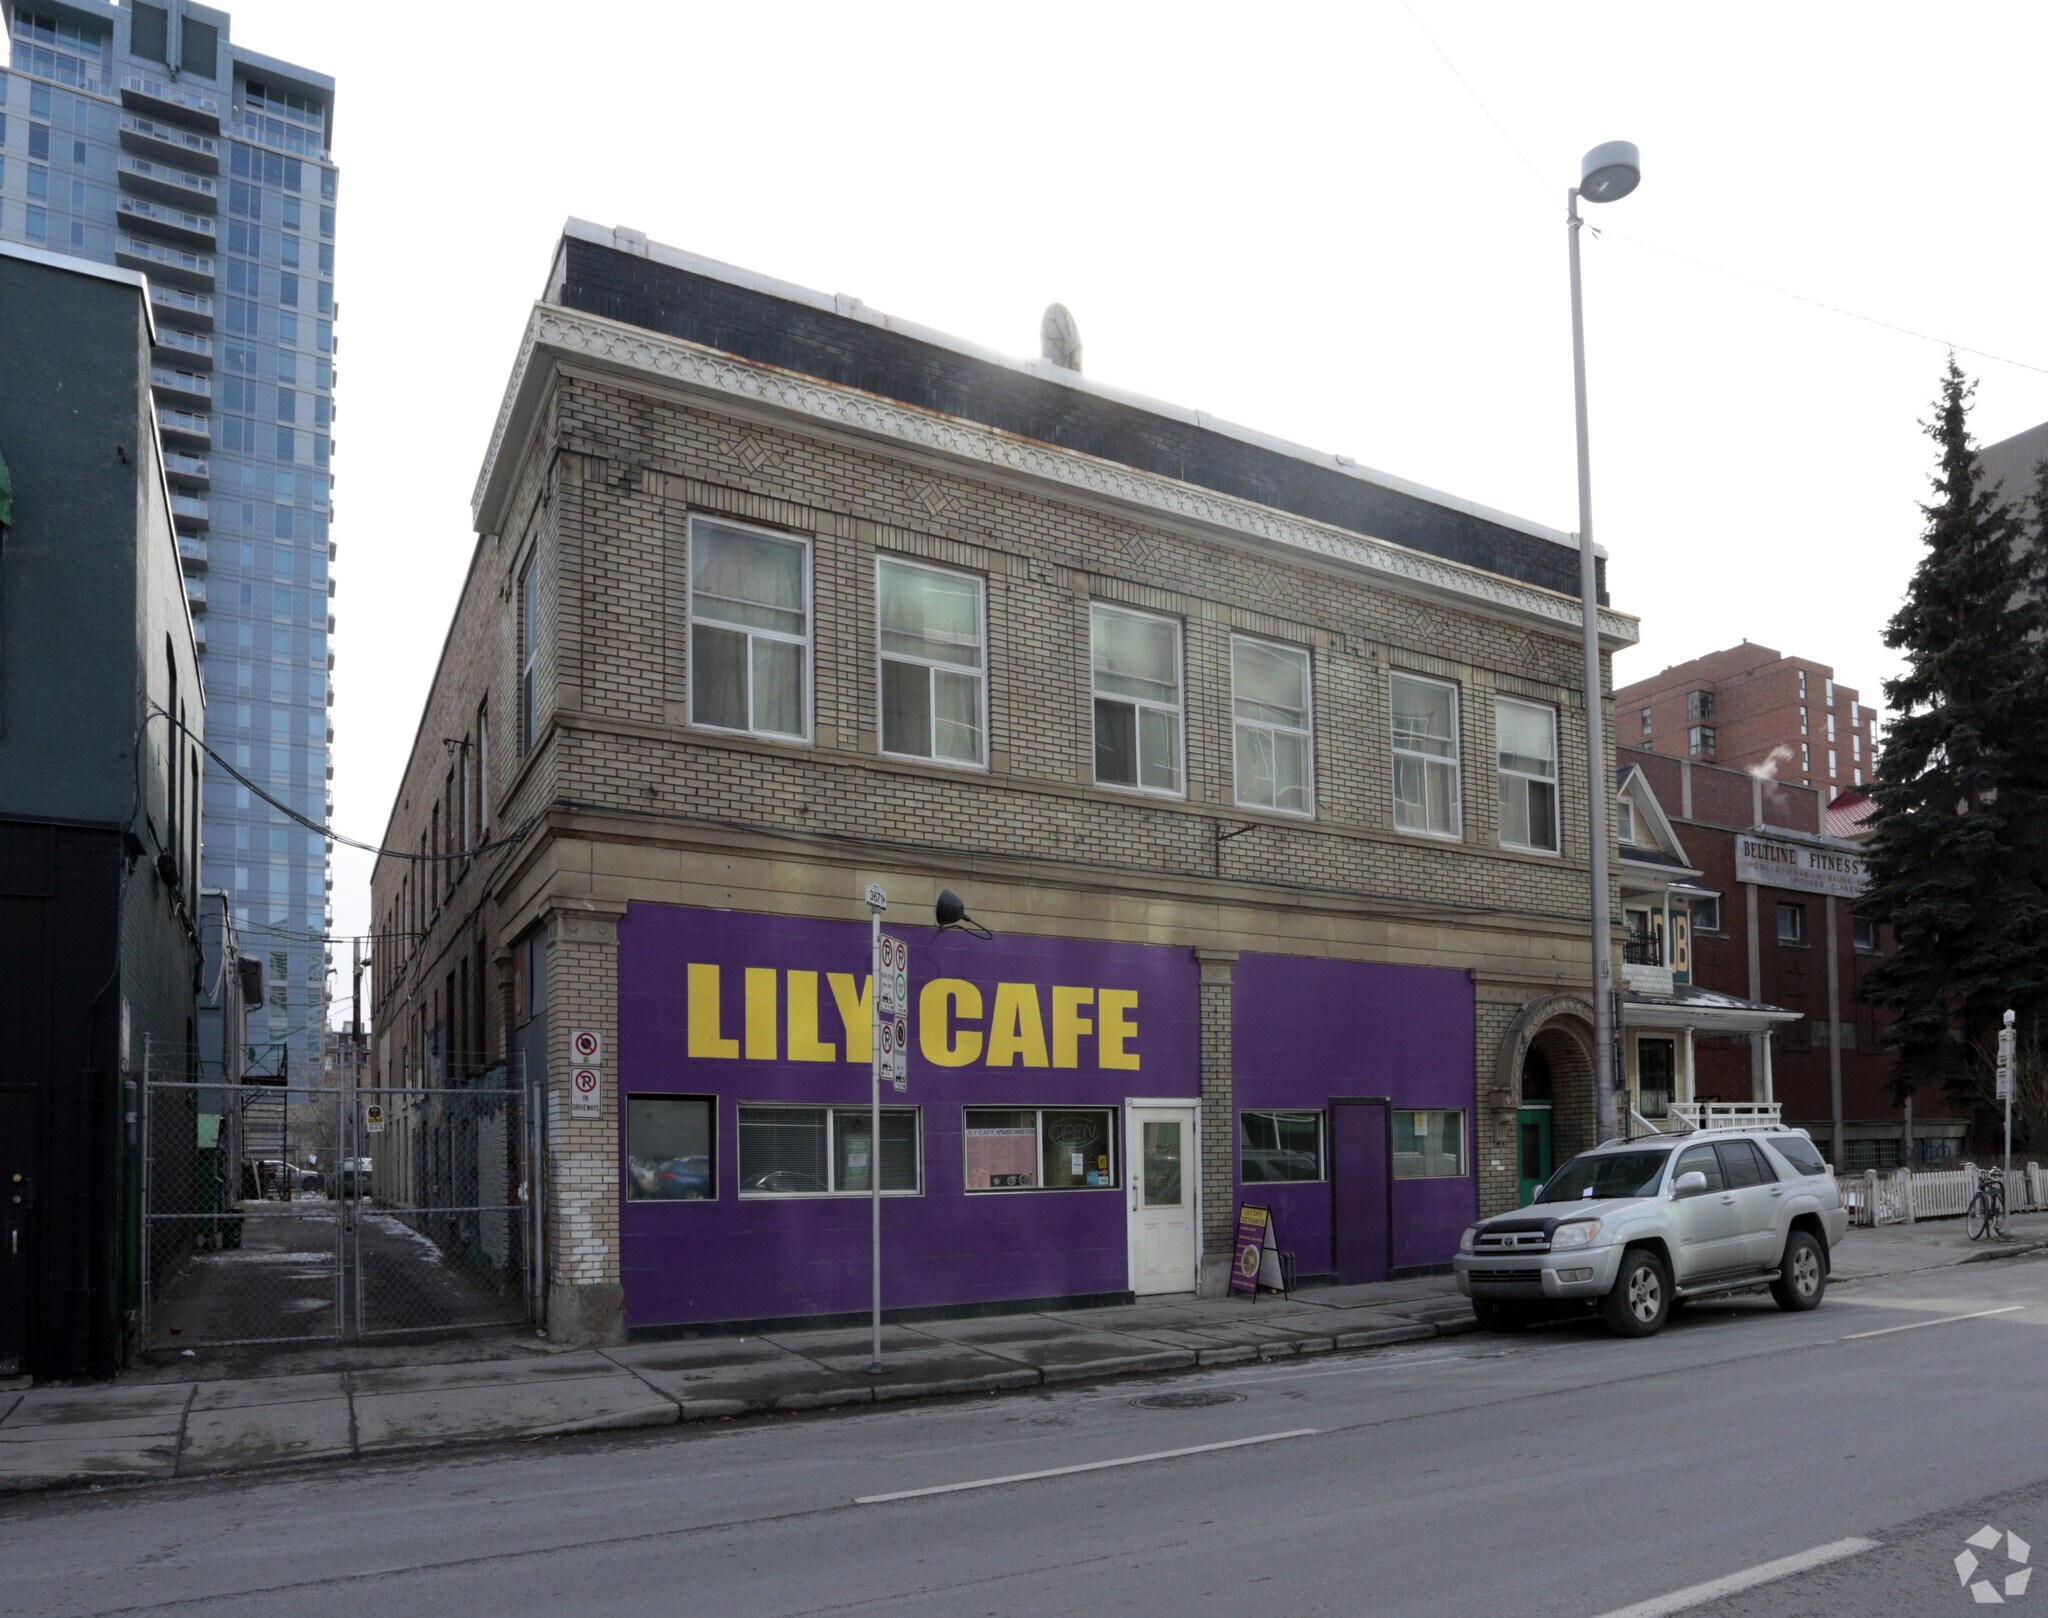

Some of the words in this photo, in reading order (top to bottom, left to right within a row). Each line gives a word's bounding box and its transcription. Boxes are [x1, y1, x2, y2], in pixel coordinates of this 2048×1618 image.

[1744, 841, 1796, 865] BELTLINE
[1810, 853, 1859, 875] FITNESS
[687, 963, 873, 1063] LILY
[919, 978, 1140, 1070] CAFE
[1051, 1123, 1096, 1140] OPEN
